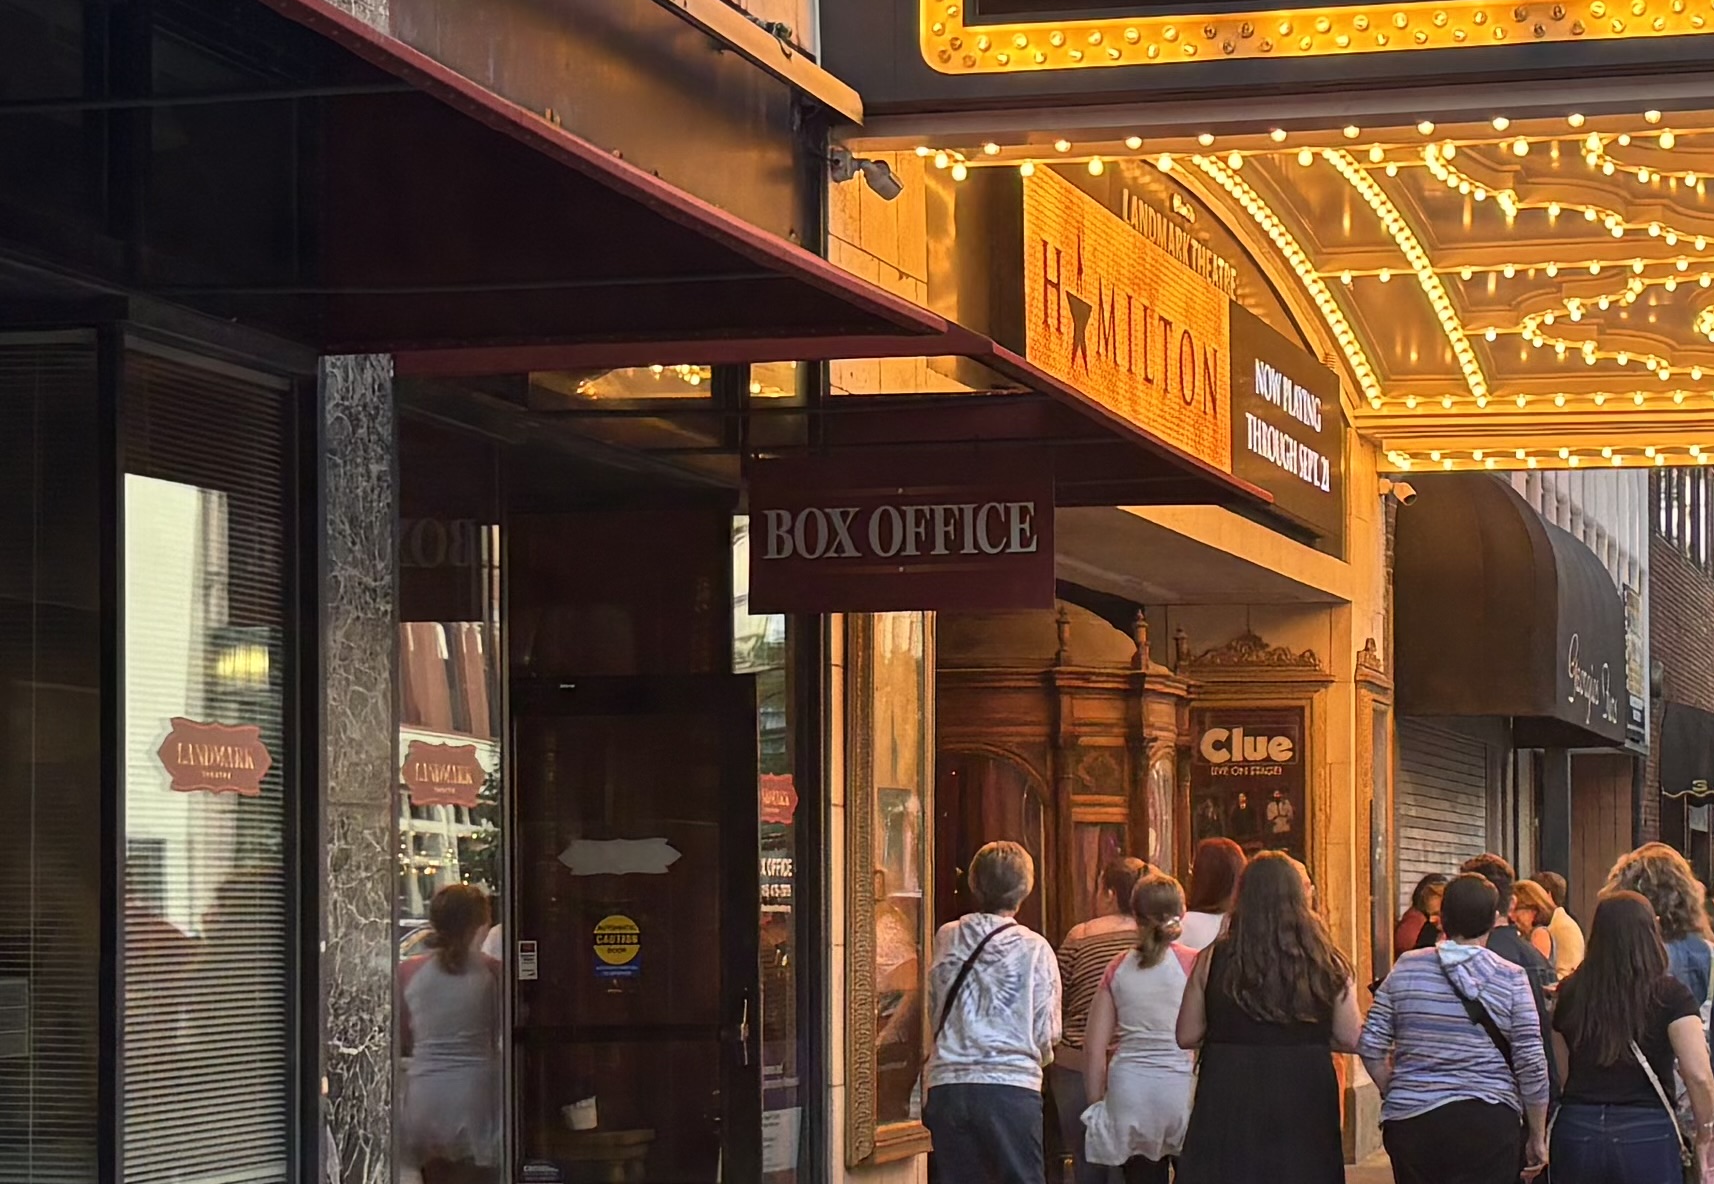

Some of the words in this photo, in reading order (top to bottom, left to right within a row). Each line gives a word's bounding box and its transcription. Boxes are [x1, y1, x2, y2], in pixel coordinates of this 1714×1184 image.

[1122, 188, 1190, 266] LANDMARK
[1190, 238, 1237, 302] THEATRE
[1255, 358, 1282, 406] NOW
[1282, 376, 1322, 433] PLAYING
[1245, 412, 1298, 475] THROUGH
[762, 507, 862, 559] BOX
[868, 502, 1037, 557] OFFICE
[177, 742, 255, 770] LANDMARK
[1200, 726, 1294, 764] Clue
